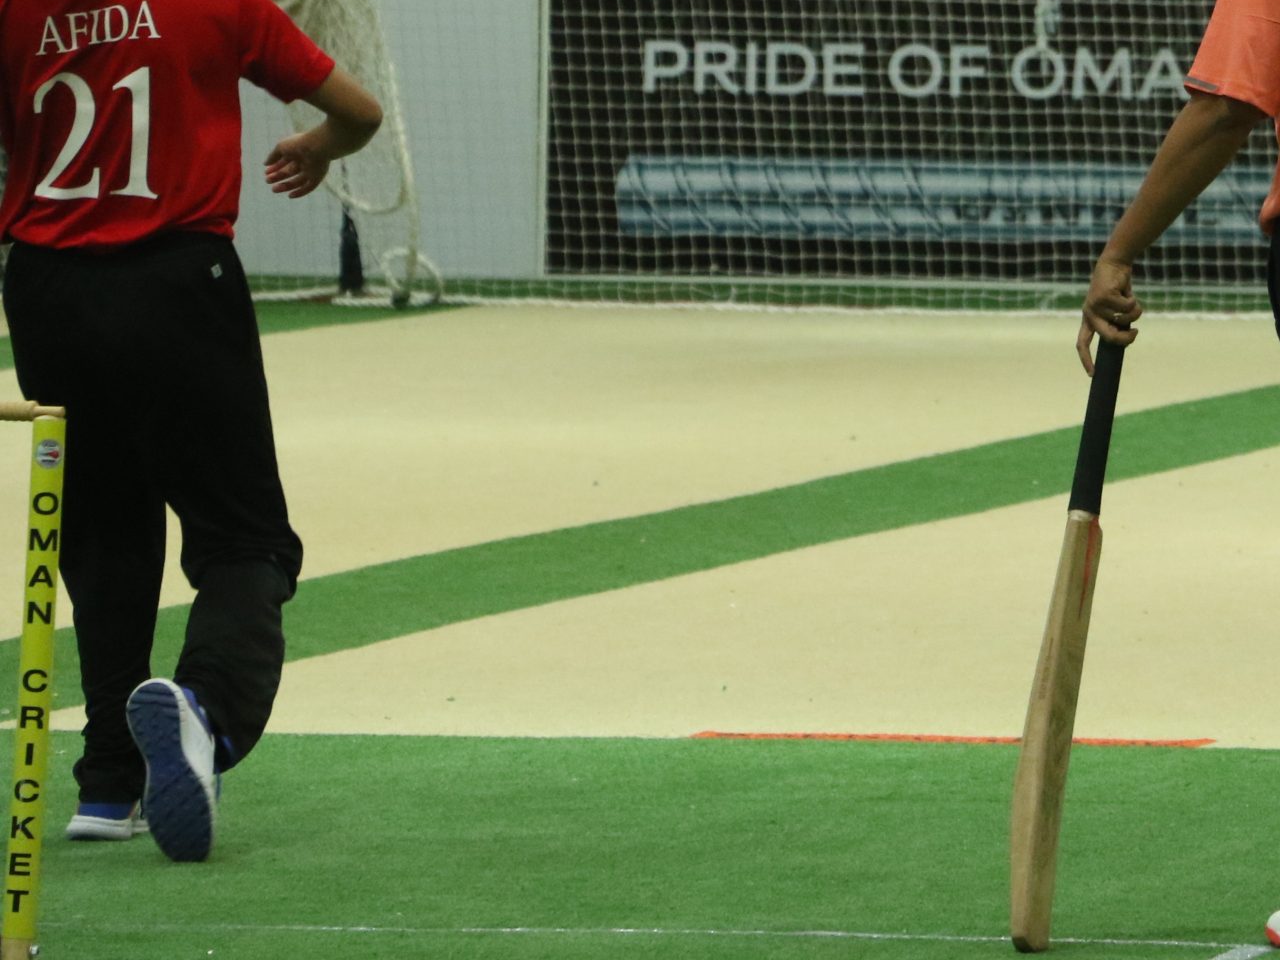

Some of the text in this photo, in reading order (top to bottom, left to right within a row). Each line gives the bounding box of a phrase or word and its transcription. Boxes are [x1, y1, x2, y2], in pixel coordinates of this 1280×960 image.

[36, 0, 161, 56] AFIDA
[643, 41, 1188, 101] PRIDE OF OMA
[33, 66, 159, 200] 21
[27, 491, 59, 625] OMAN
[7, 669, 48, 913] CRICKET
